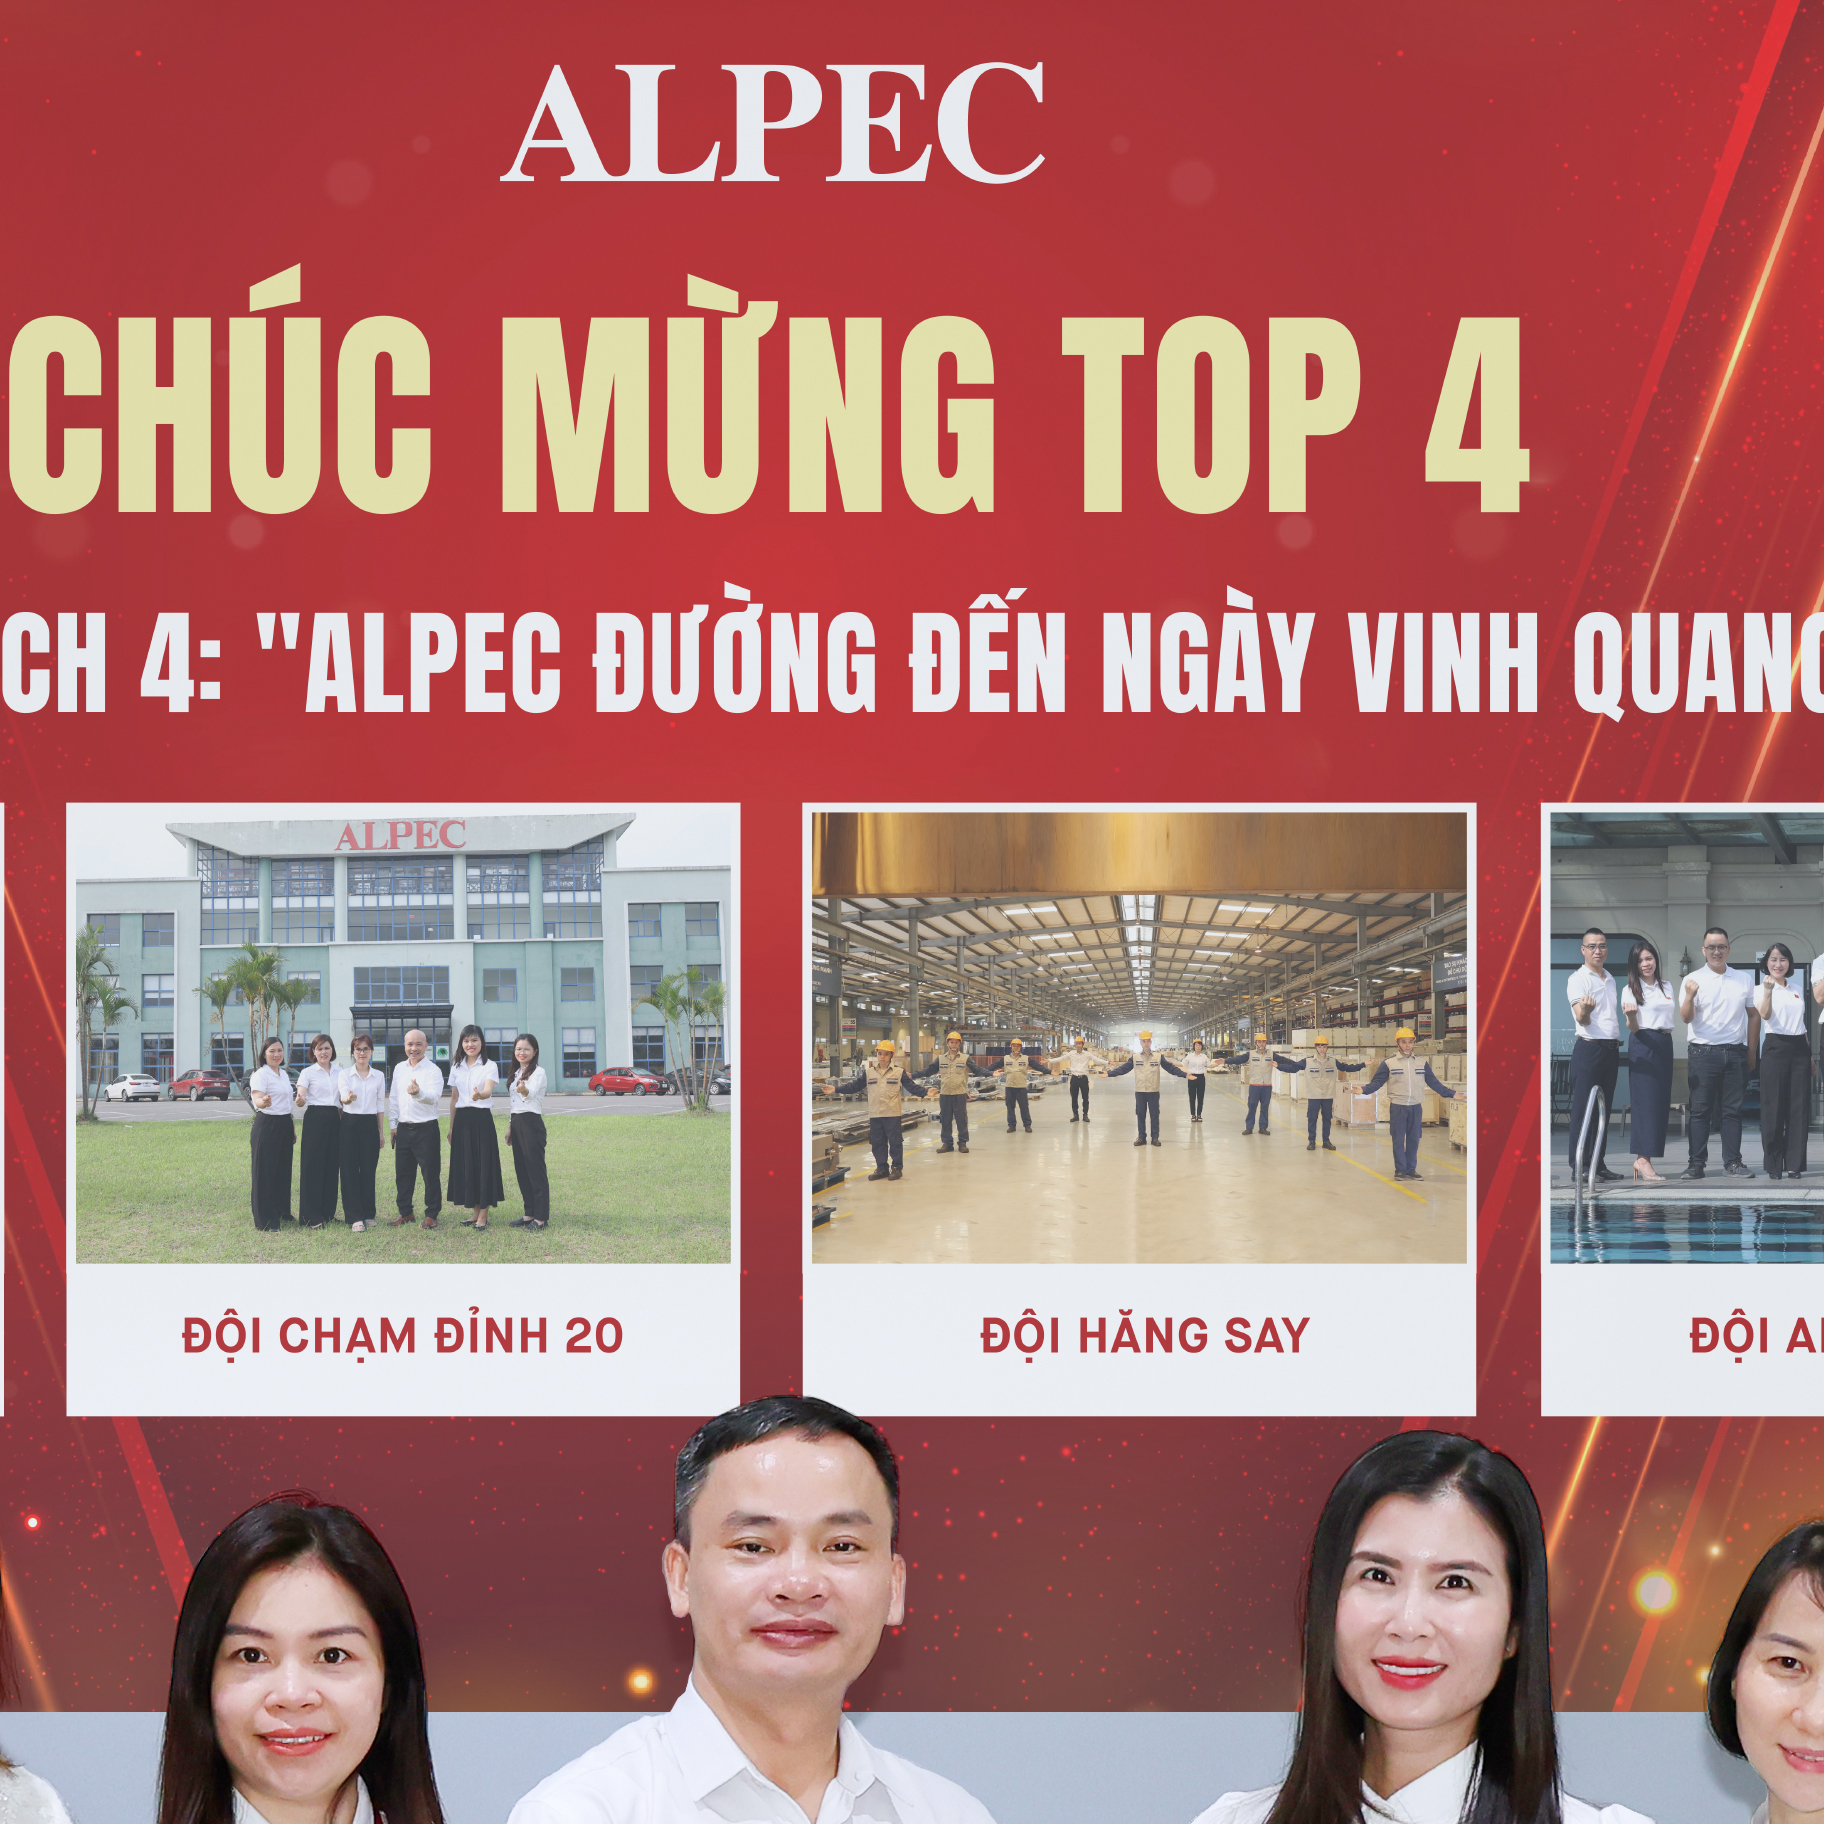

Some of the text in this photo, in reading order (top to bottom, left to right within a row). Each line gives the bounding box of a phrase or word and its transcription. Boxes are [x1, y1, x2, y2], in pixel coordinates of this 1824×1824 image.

[500, 62, 1046, 184] ALPEC
[9, 263, 1530, 515] CHÚC MỪNG TOP 4
[141, 613, 221, 713] 4:
[257, 612, 561, 714] "ALPEC
[593, 581, 876, 714] ĐƯỜNG
[909, 587, 1066, 713] ĐẾN
[1104, 585, 1316, 714] NGÀY
[1348, 613, 1538, 713] VINH
[334, 820, 467, 851] ALPEC
[182, 1305, 623, 1364] ĐỘI CHẠM ĐỈNH 20
[981, 1308, 1311, 1364] ĐỘI HĂNG SAY
[1690, 1308, 1768, 1364] ĐỘI
